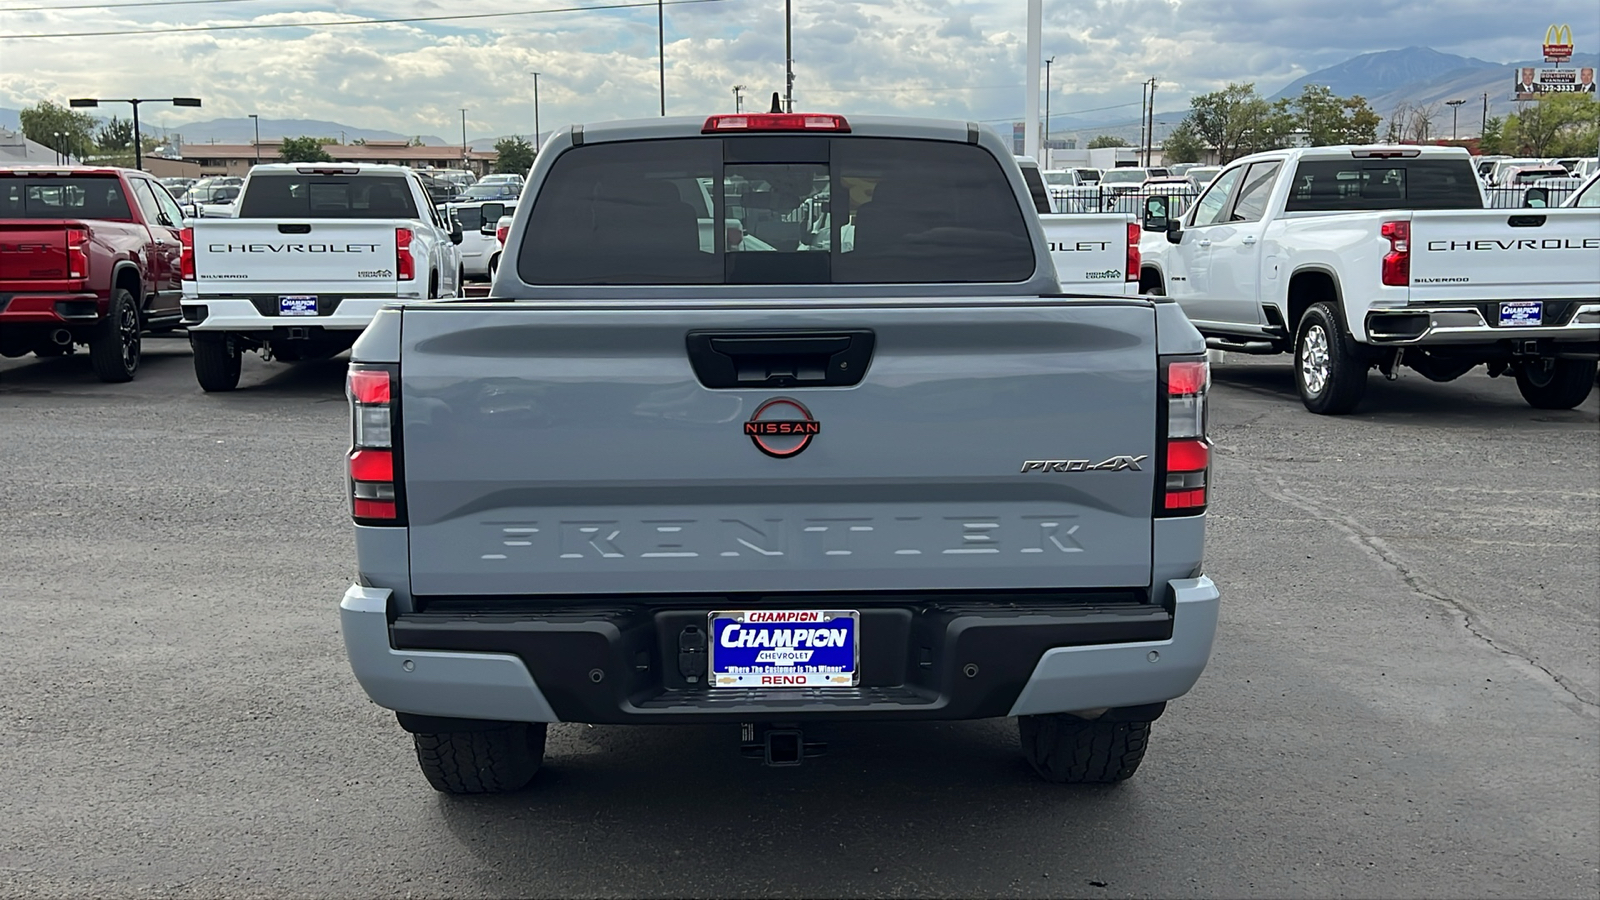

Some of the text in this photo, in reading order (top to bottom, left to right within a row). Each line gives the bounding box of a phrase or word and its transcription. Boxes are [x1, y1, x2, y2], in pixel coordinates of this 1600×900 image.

[209, 243, 381, 253] CHEVROLET
[282, 299, 316, 307] CHAMPION
[1502, 306, 1540, 314] CHAMPION
[746, 423, 818, 434] NISSAN
[1021, 455, 1148, 473] PRO-4X
[480, 515, 1084, 560] FRONTIER
[749, 612, 818, 622] CHAMPION
[720, 624, 848, 648] CHAMPION
[759, 652, 809, 660] CHEVROLET
[751, 665, 764, 673] The
[764, 665, 797, 673] Customer
[805, 665, 817, 673] The
[761, 676, 807, 685] RENO
